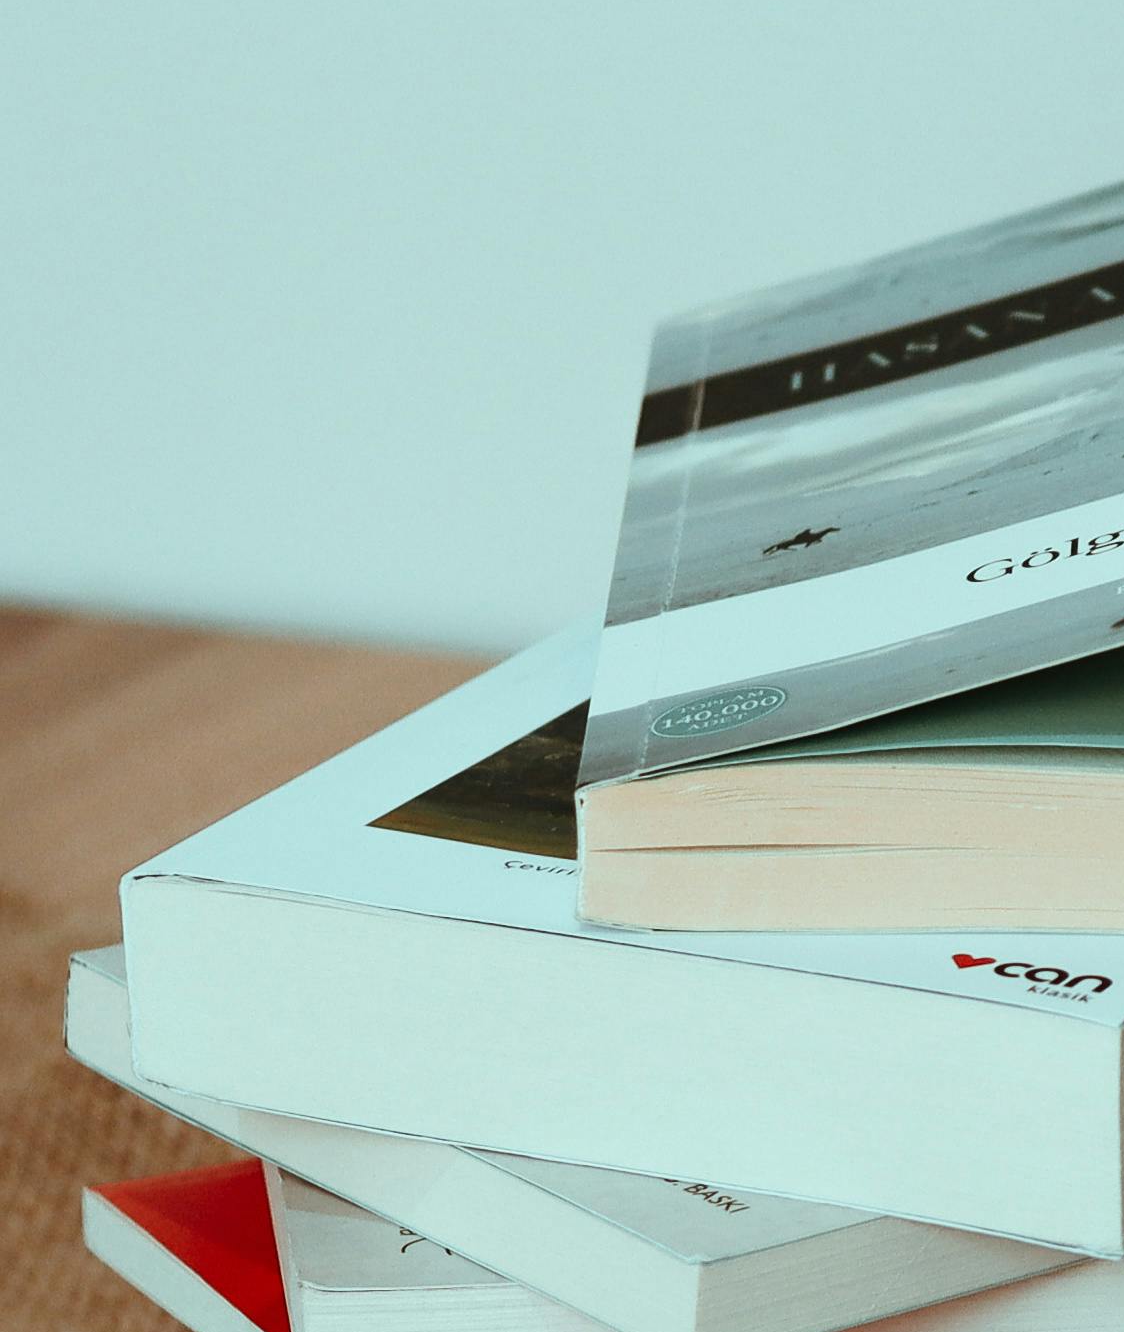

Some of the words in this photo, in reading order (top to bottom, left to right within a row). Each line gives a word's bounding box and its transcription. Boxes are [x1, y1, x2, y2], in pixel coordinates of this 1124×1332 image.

[788, 300, 1048, 393] HASAN
[660, 695, 778, 729] 140.000
[688, 711, 749, 731] ADET
[993, 962, 1114, 994] can
[1027, 985, 1092, 1003] klasik
[683, 1183, 750, 1215] BASKI
